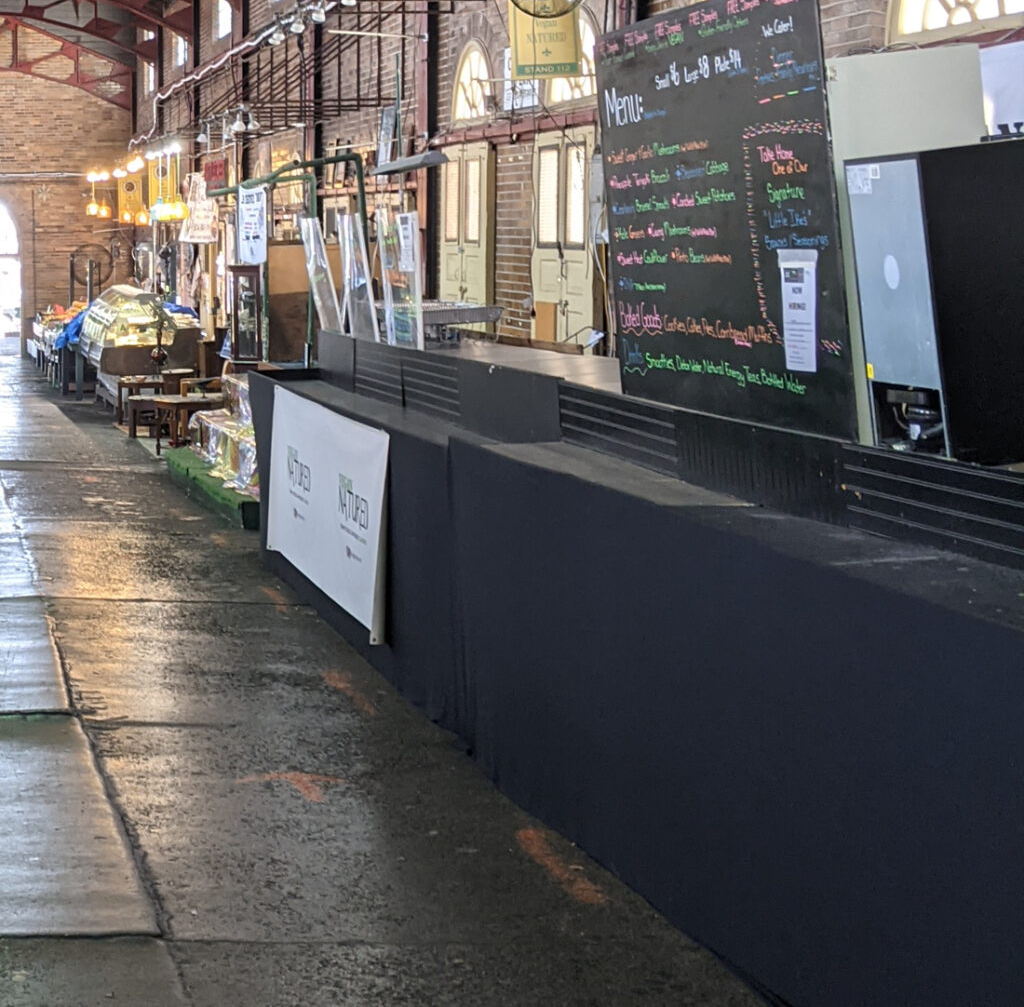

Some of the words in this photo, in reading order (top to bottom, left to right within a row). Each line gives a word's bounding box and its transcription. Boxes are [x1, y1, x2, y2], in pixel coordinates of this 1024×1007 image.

[536, 20, 558, 28] Vegan
[761, 23, 774, 38] We
[774, 15, 795, 34] Cater!
[526, 33, 567, 44] NATURED
[524, 65, 555, 74] STAND
[556, 64, 571, 73] 112
[655, 73, 671, 91] Small
[683, 66, 699, 84] Large
[698, 54, 710, 79] $8
[714, 55, 730, 74] Plate
[604, 86, 644, 129] Menu:
[756, 145, 776, 163] Take
[774, 143, 795, 160] Home
[771, 160, 787, 176] One
[793, 159, 809, 174] Our
[765, 181, 806, 209] Signature
[619, 300, 641, 329] Baked
[783, 372, 808, 395] Water
[338, 485, 368, 531] NATURED
